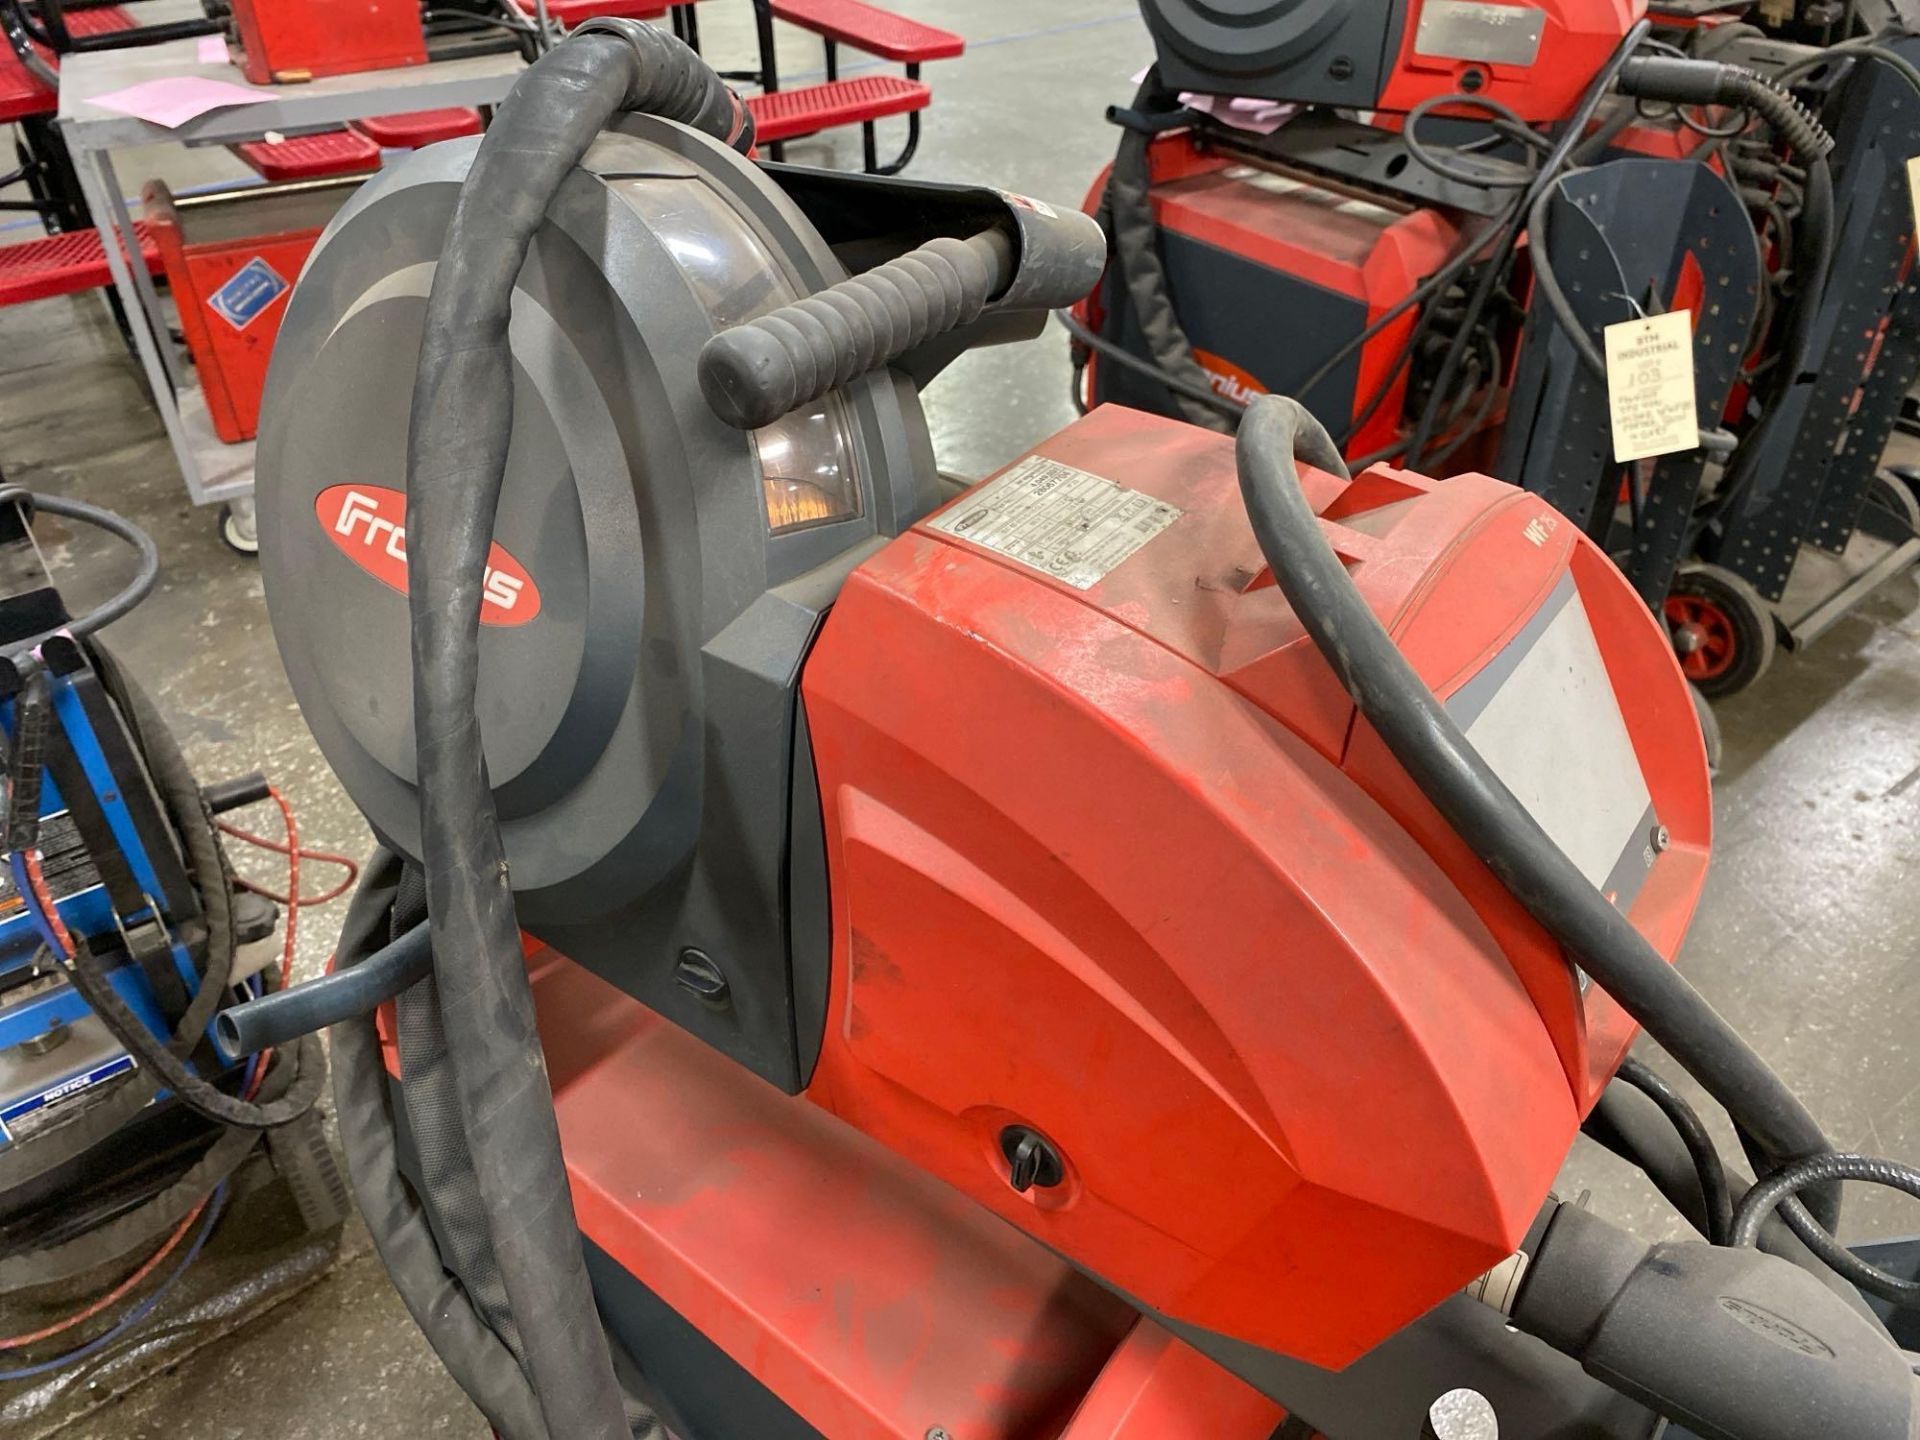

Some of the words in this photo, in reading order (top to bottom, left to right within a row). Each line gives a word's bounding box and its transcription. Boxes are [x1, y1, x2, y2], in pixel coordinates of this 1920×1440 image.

[1617, 340, 1679, 360] INDUSTRIAL
[1522, 518, 1549, 547] WF
[43, 1075, 92, 1102] NOTICE
